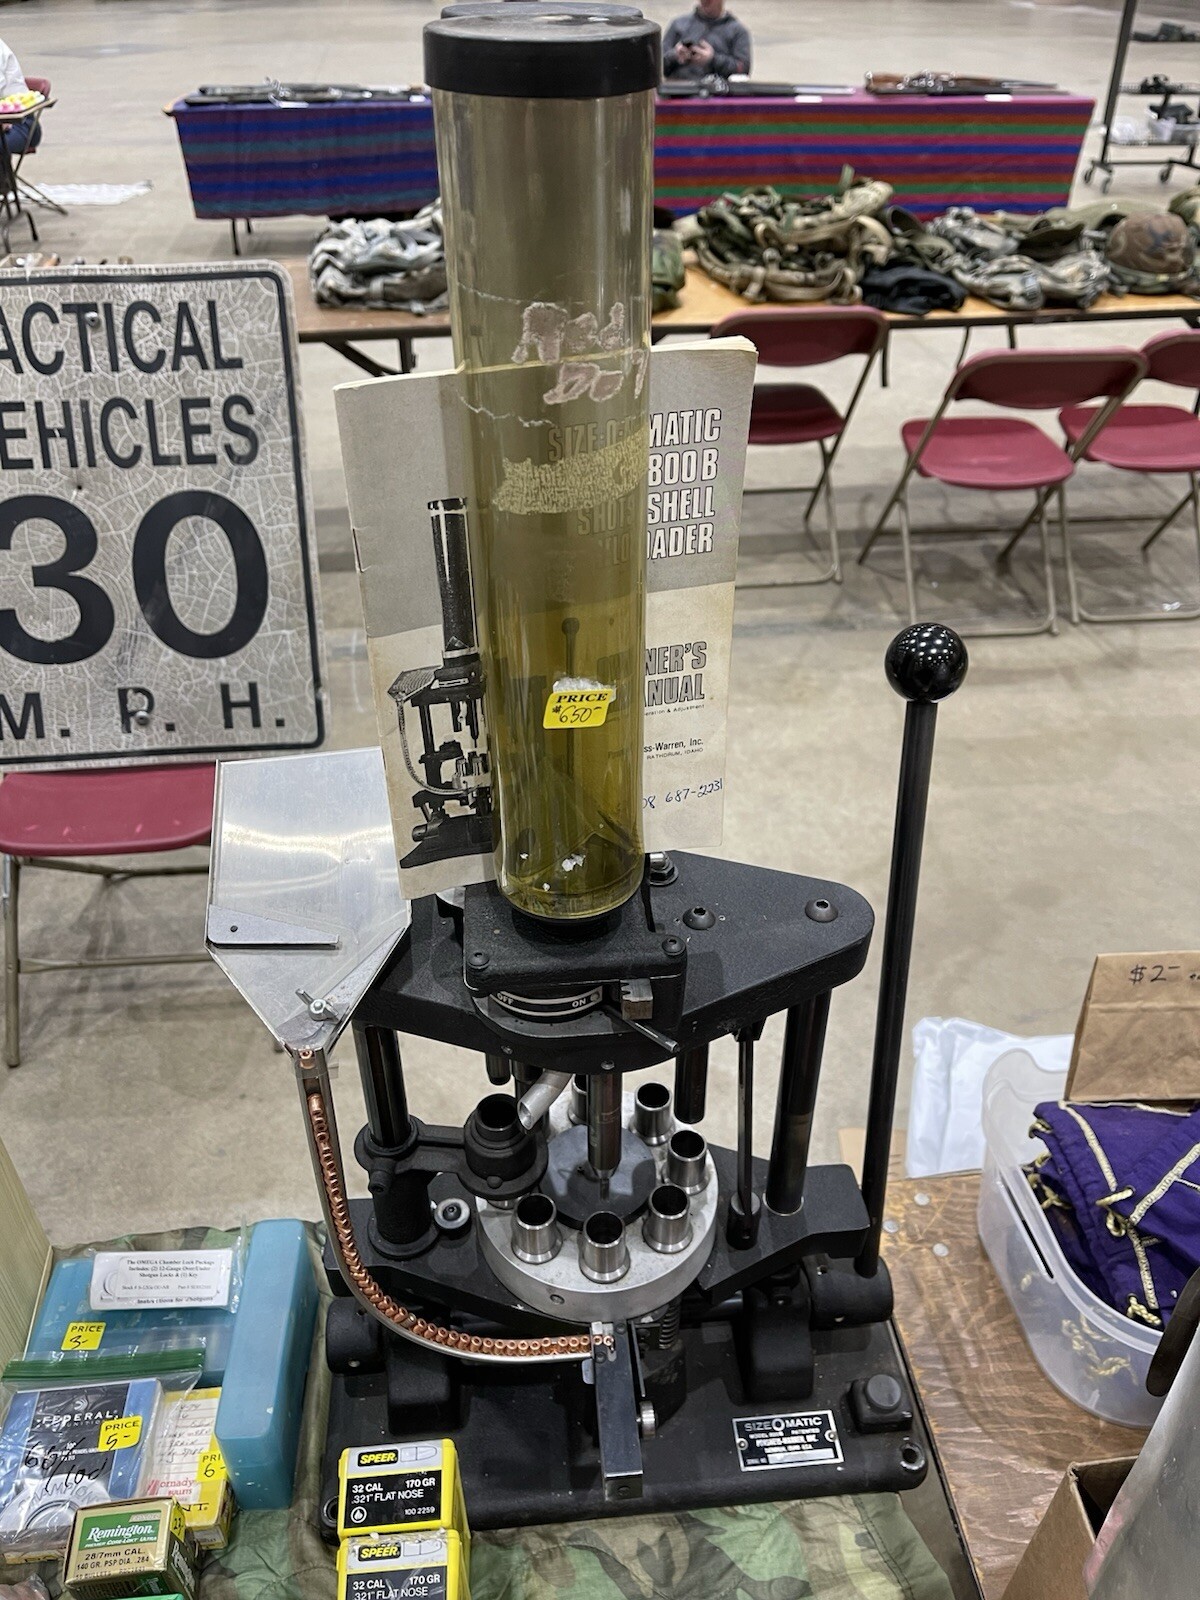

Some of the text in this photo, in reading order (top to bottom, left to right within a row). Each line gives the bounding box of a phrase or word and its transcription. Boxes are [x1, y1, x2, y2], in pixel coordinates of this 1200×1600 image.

[648, 486, 715, 525] SHELL
[647, 523, 715, 560] ADER
[0, 490, 269, 665] 30
[645, 674, 705, 708] NUAL
[556, 693, 608, 703] PRICE
[118, 688, 175, 734] P.
[220, 682, 287, 730] H.
[673, 704, 705, 712] Adjustment
[690, 738, 704, 747] Inc.
[684, 747, 704, 755] IDAHO
[496, 992, 586, 1008] OFF ON
[70, 1325, 103, 1333] PRICE
[42, 1410, 114, 1425] FEDERAL
[105, 1421, 140, 1432] PRICE
[359, 1452, 397, 1465] SPEER
[352, 1477, 436, 1494] 32 CAL 170 GR
[374, 1491, 397, 1502] FLAT
[398, 1489, 424, 1500] NOSE
[404, 1506, 436, 1516] 100 2259
[86, 1523, 152, 1543] Remington
[124, 1548, 146, 1556] CAL.
[360, 1546, 399, 1559] SPEER
[77, 1562, 89, 1571] 140
[104, 1559, 118, 1567] PSP
[353, 1574, 441, 1590] 32 CAL 170 GR
[376, 1589, 399, 1600] FLAT
[400, 1586, 429, 1597] NOSE
